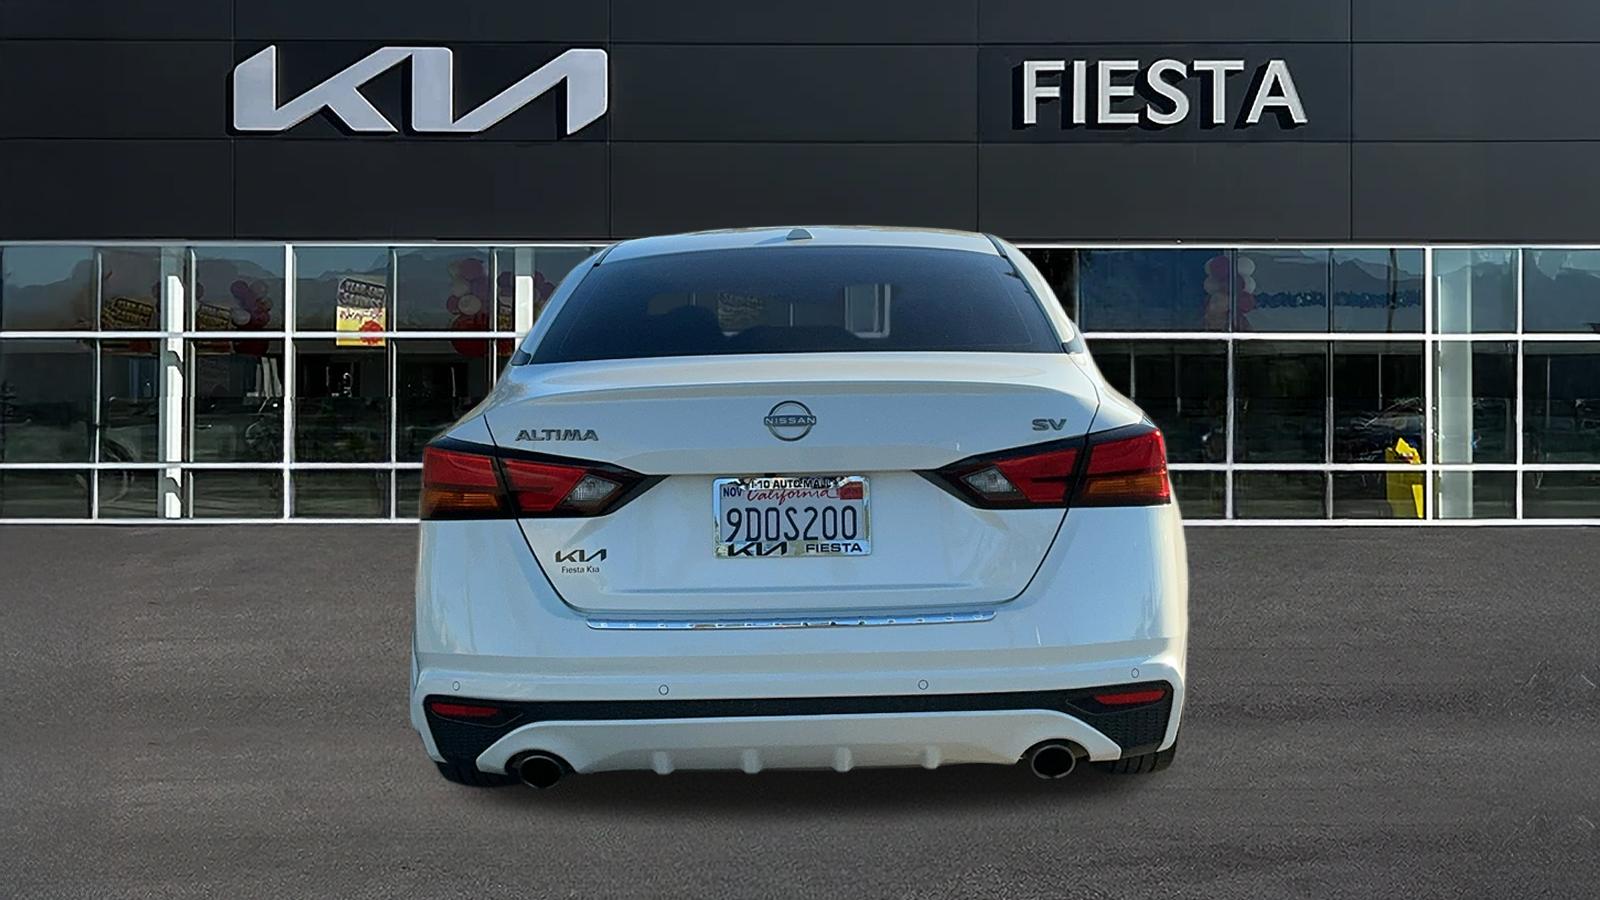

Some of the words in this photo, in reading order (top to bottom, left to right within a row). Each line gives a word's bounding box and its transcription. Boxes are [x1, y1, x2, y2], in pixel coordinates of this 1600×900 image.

[233, 44, 608, 135] KIA
[1023, 58, 1308, 125] FIESTA
[765, 416, 816, 425] NISSAN
[1031, 418, 1067, 431] SV
[515, 429, 599, 441] ALTIMA
[773, 479, 802, 489] AUTO
[722, 486, 743, 497] NOV
[746, 488, 830, 506] California
[805, 543, 863, 553] FIESTA
[561, 565, 585, 574] Fiesta
[586, 565, 600, 573] Kia
